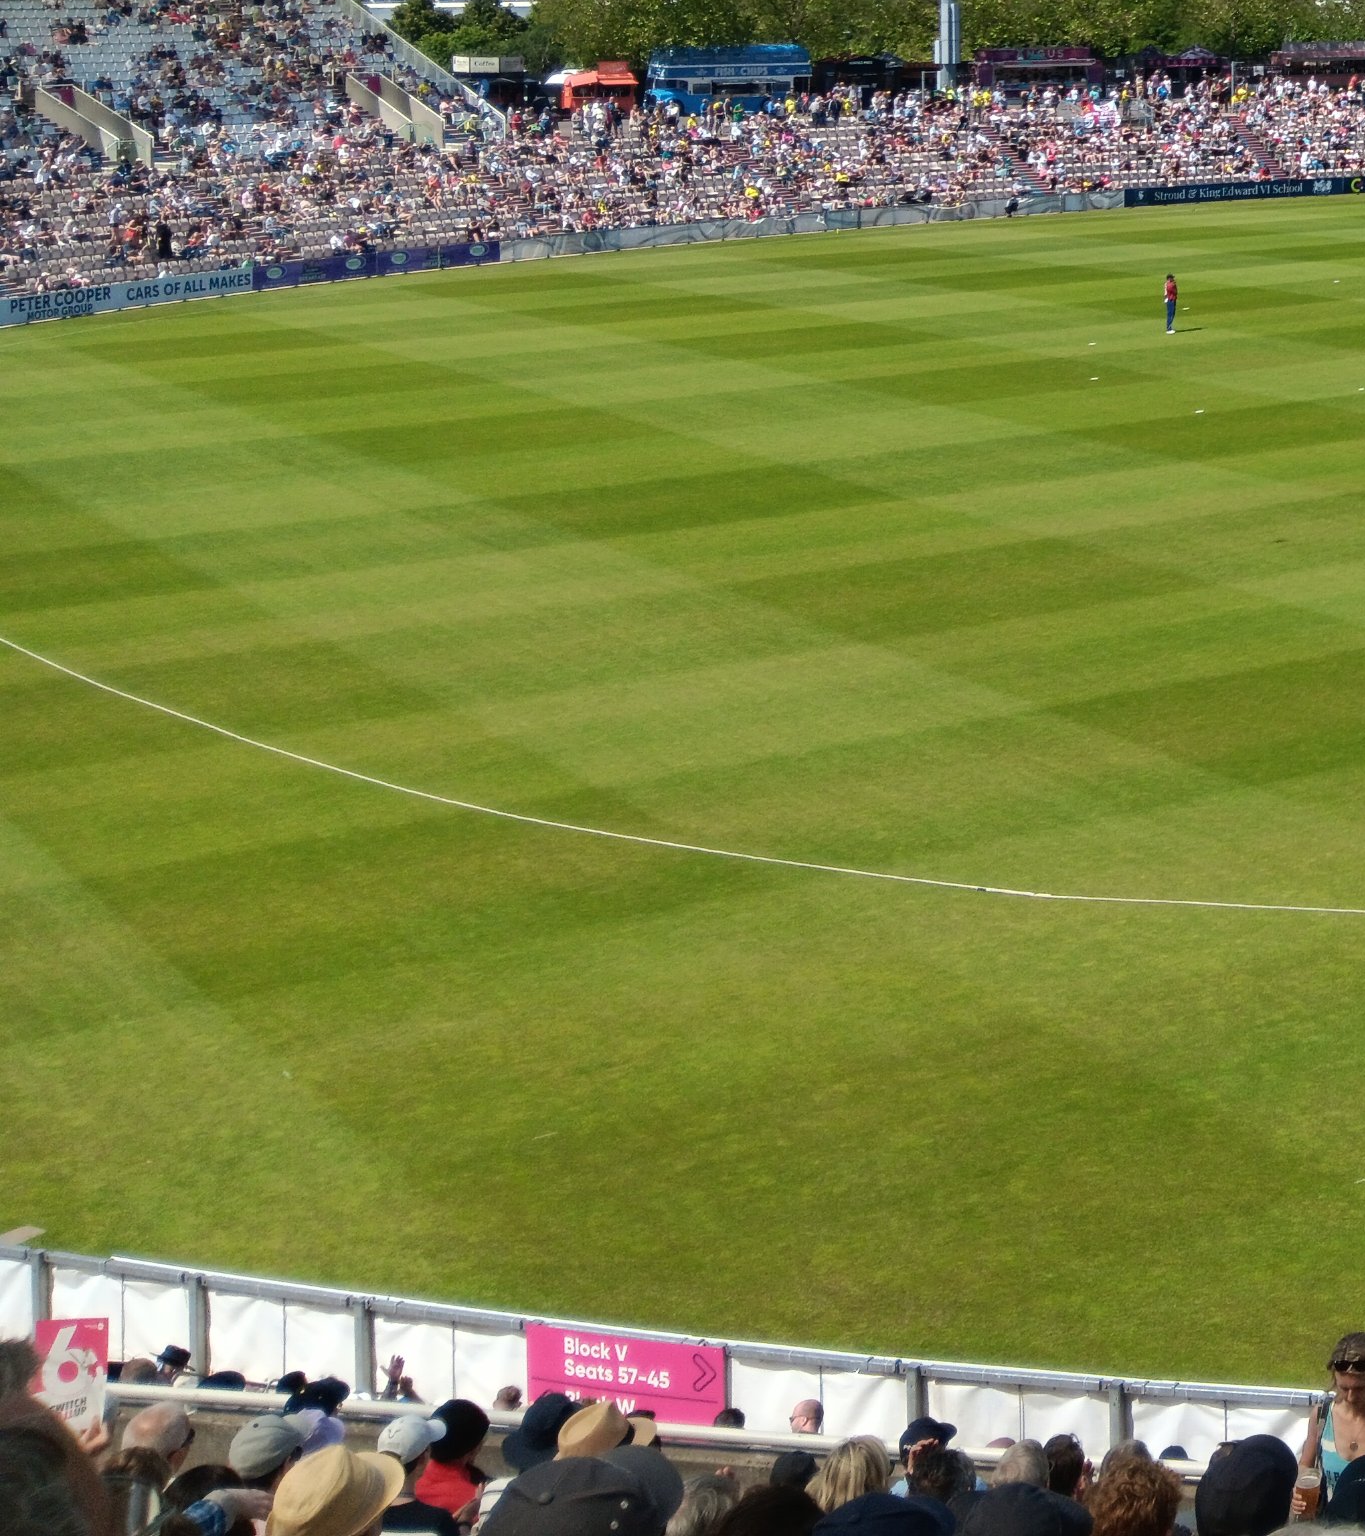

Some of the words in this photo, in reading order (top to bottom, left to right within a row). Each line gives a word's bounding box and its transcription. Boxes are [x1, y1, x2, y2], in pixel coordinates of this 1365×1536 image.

[715, 68, 735, 76] FISH
[740, 67, 768, 76] CHIPS
[1155, 189, 1186, 201] Stroud
[1188, 189, 1198, 199] &
[1200, 188, 1221, 198] King
[1222, 185, 1258, 197] Edward
[1261, 185, 1270, 195] VI
[1273, 183, 1303, 194] School
[10, 295, 51, 314] PETER
[54, 286, 111, 306] COOPER
[127, 285, 159, 301] CARS
[164, 282, 181, 296] OF
[183, 279, 206, 294] ALL
[209, 273, 251, 290] MAKES
[26, 307, 59, 321] MOTOR
[61, 304, 93, 316] GROUP
[42, 1324, 88, 1396] 6
[563, 1336, 611, 1360] Block
[614, 1344, 628, 1362] V
[564, 1359, 613, 1382] Seats
[618, 1367, 670, 1389] 57-45
